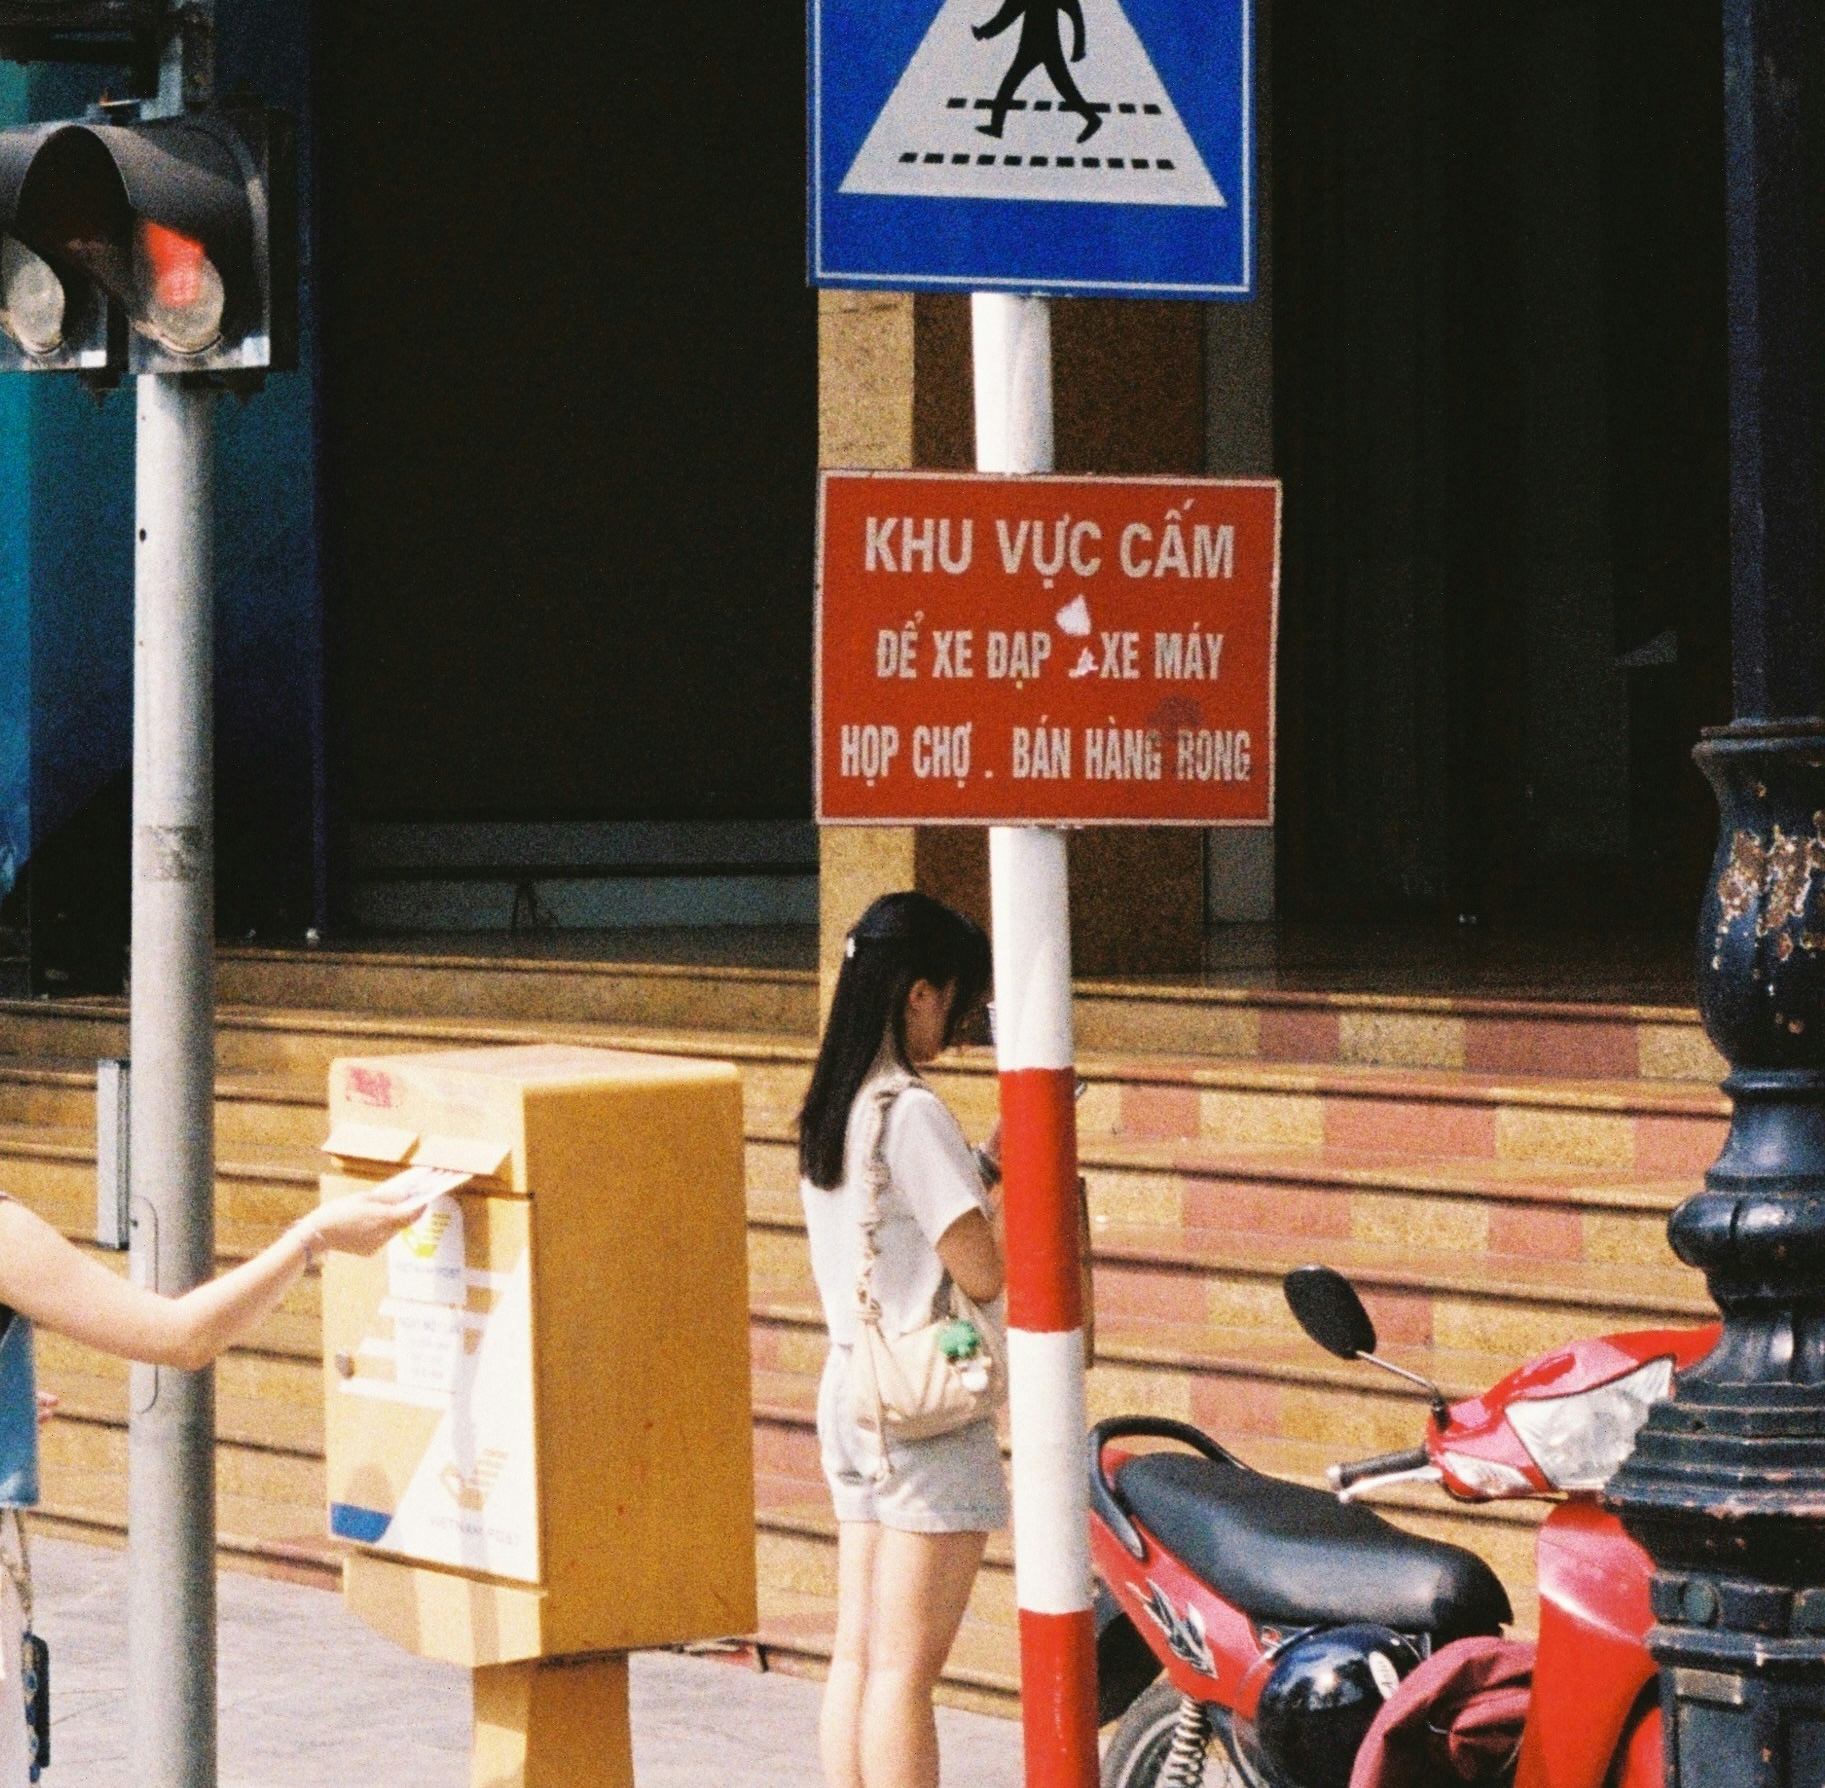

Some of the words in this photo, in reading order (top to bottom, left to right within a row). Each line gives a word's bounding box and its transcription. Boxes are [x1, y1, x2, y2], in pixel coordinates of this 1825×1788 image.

[864, 516, 974, 575] KHU
[995, 512, 1104, 589] VỰC
[1119, 497, 1236, 580] CẤM
[876, 610, 925, 680] ĐỂ
[931, 629, 974, 680] XE
[986, 630, 1052, 690] ĐẠP
[1099, 631, 1141, 680] XE
[1154, 622, 1225, 681] MÁY
[840, 724, 899, 788] HỌP
[912, 721, 973, 789] CHỢ
[1012, 714, 1072, 781] BÁN
[1084, 715, 1163, 782] HÀNG
[1177, 728, 1252, 783] RONG
